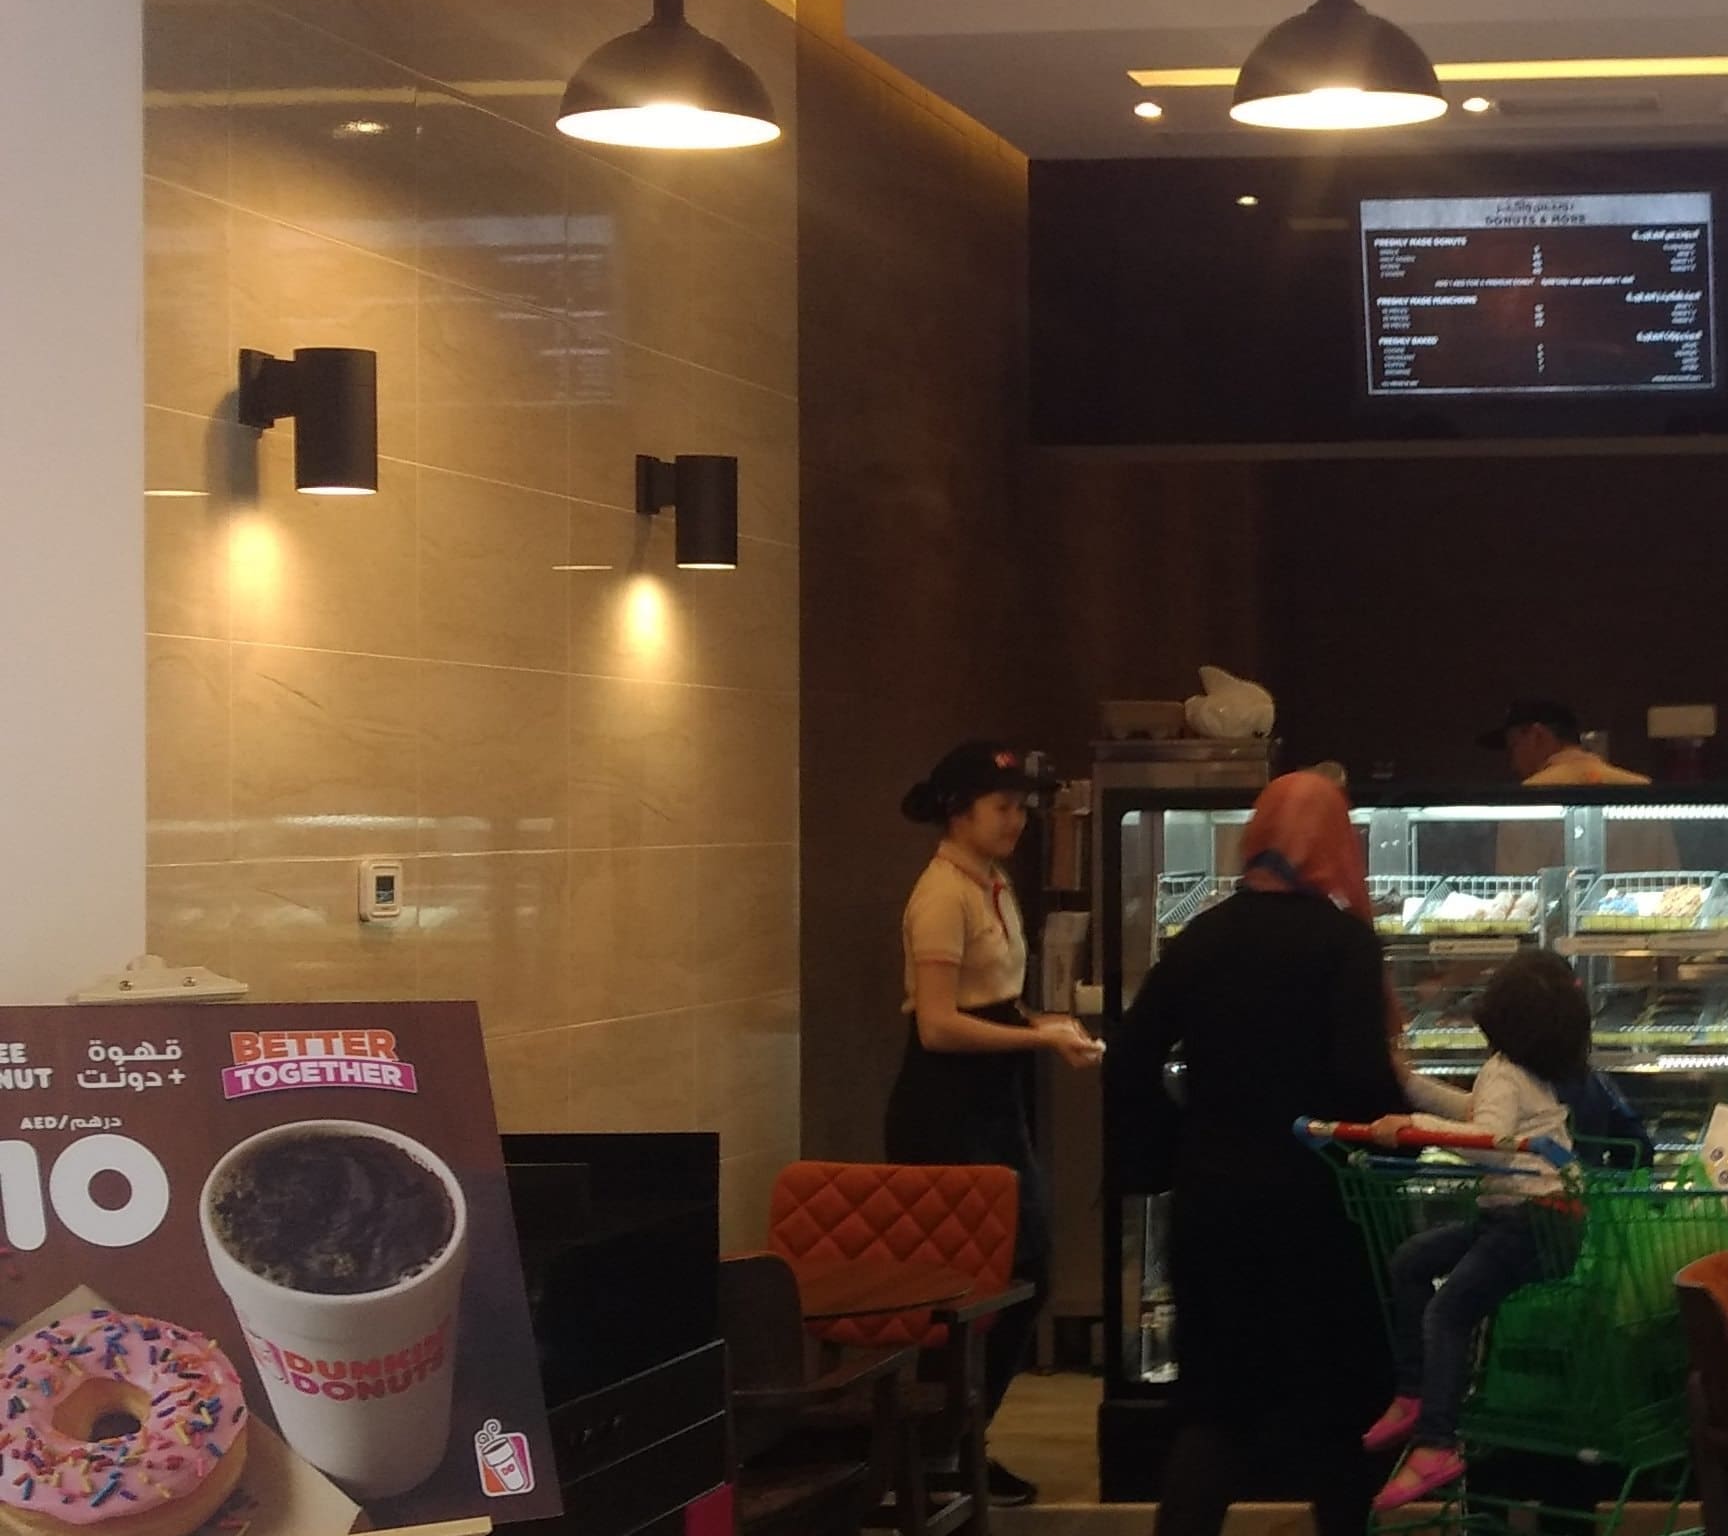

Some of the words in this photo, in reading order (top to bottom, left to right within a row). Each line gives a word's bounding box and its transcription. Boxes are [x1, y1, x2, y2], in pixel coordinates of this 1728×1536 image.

[88, 1039, 182, 1066] قهوة
[230, 1030, 398, 1065] BETTER
[77, 1066, 163, 1092] دونت
[234, 1061, 403, 1091] TOGETHER
[0, 1133, 170, 1251] 10
